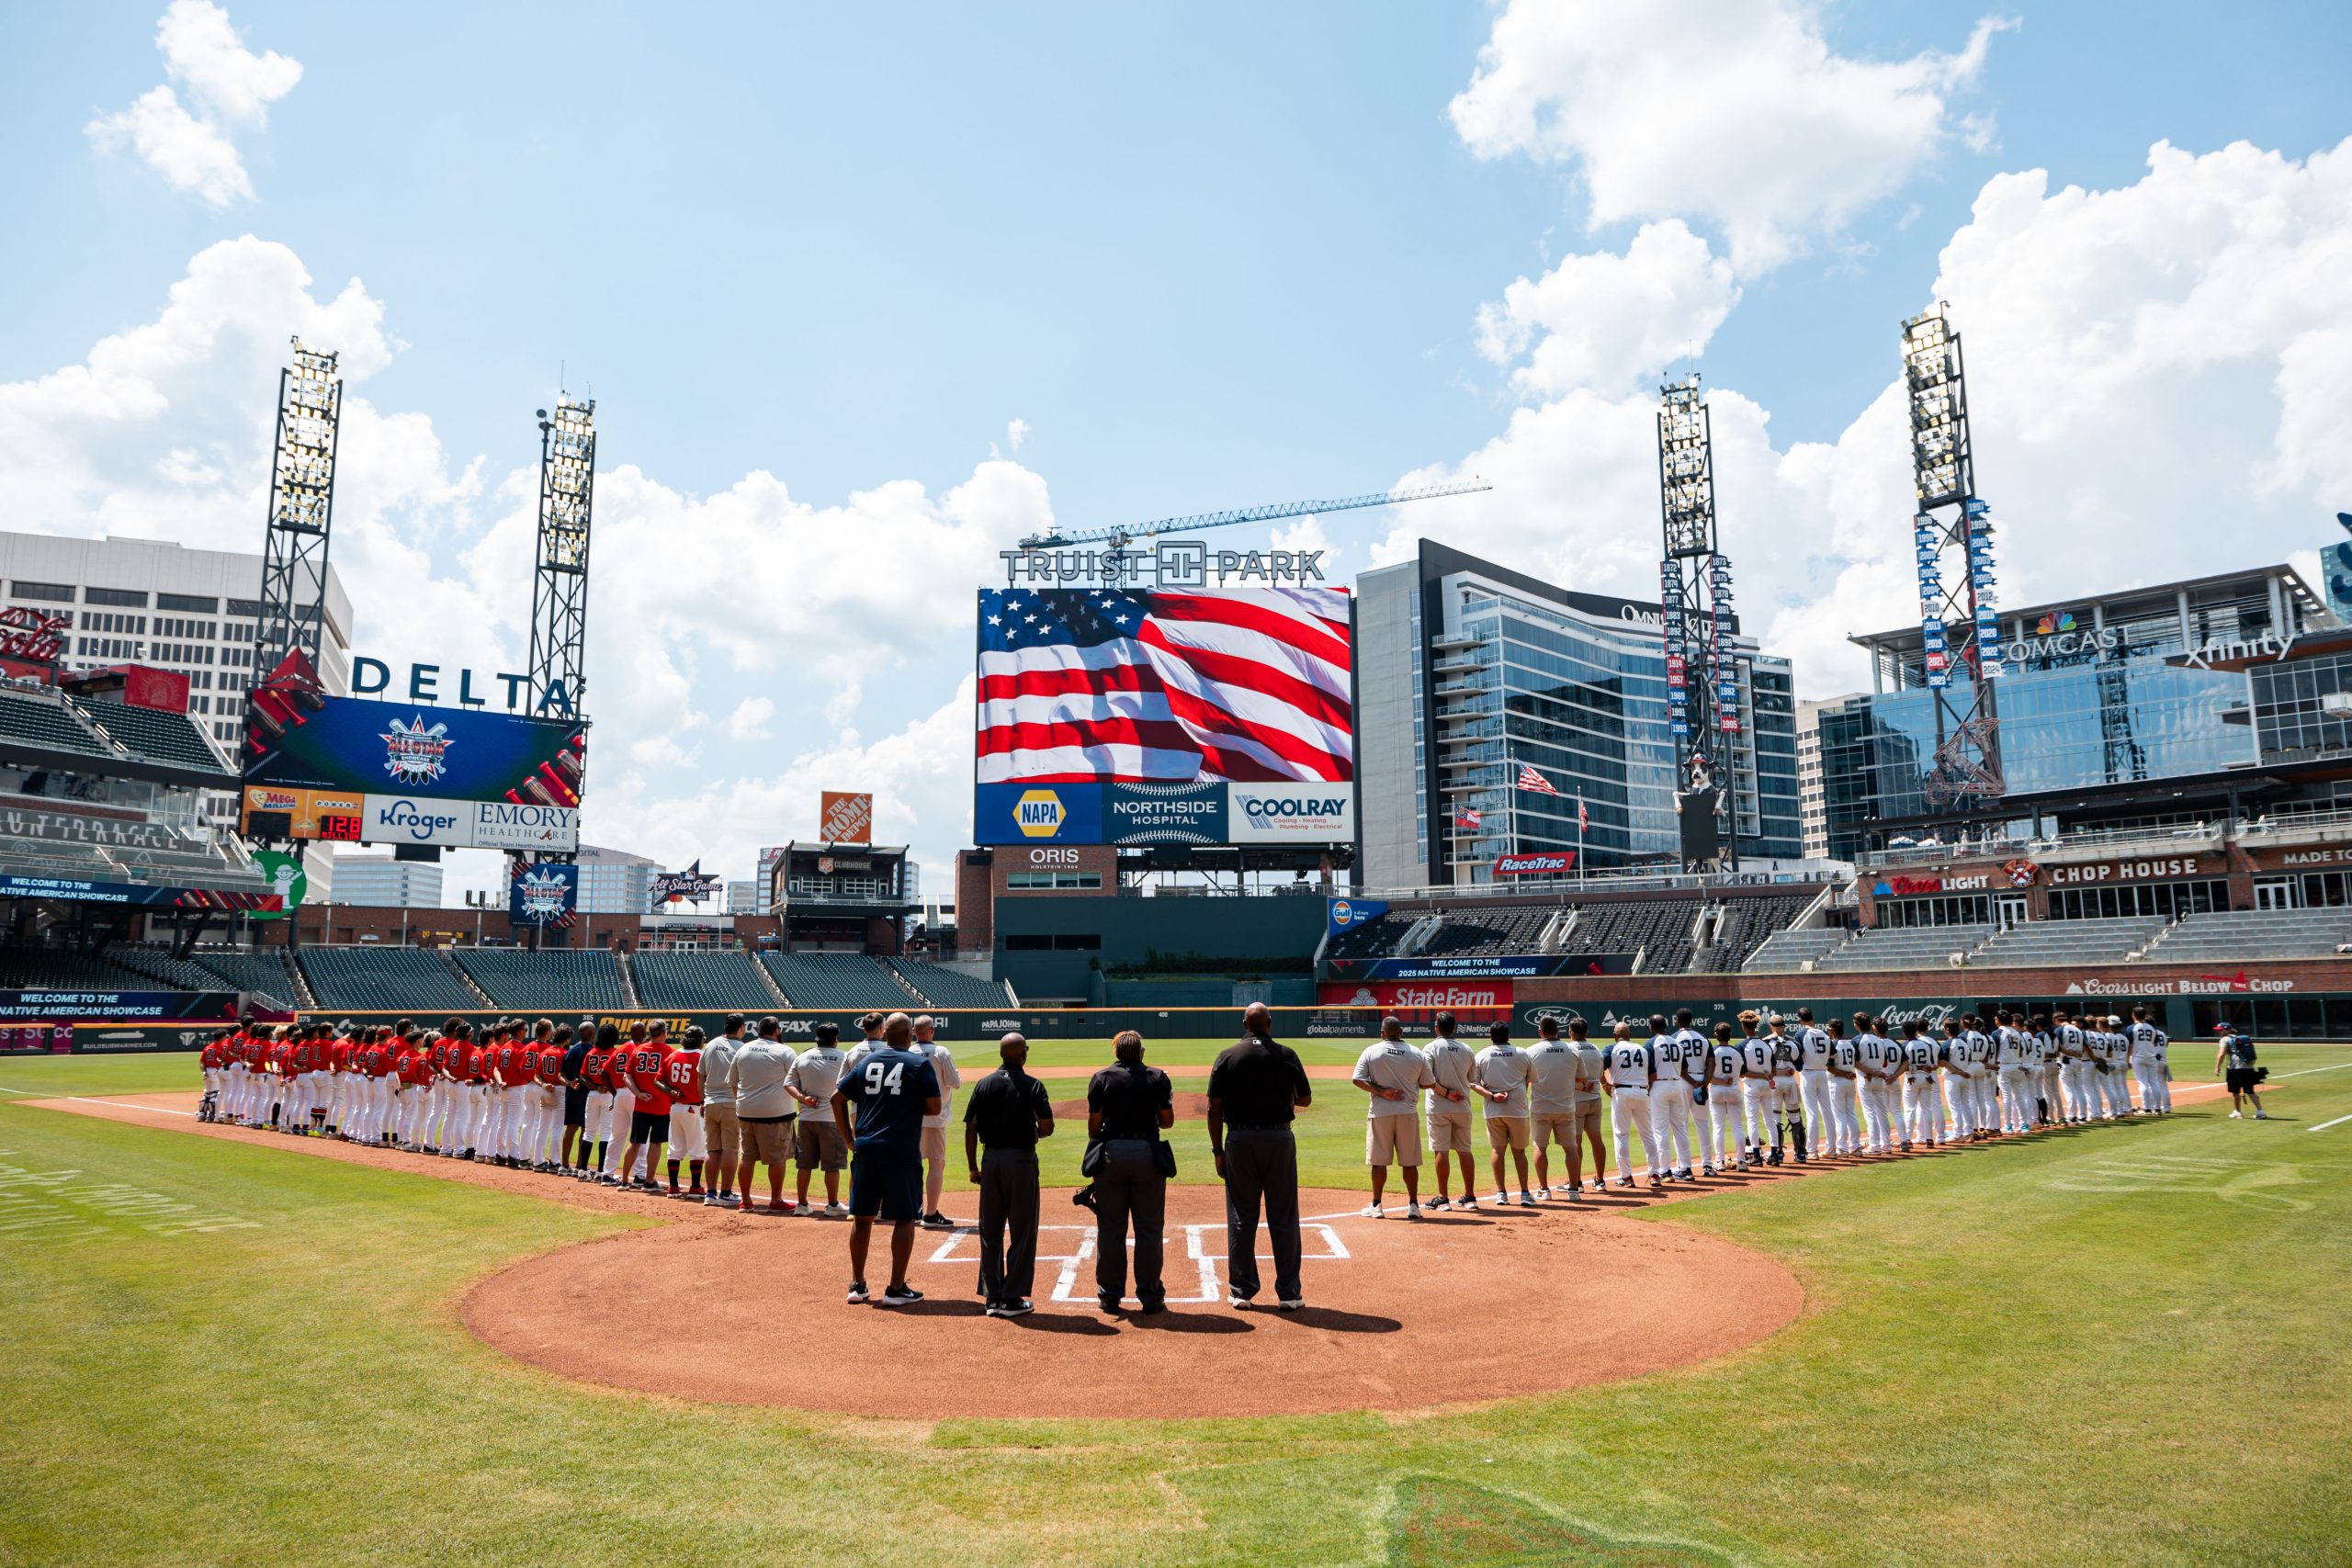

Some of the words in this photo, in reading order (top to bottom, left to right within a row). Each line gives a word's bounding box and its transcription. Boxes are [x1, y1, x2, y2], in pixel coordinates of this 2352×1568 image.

[999, 550, 1148, 582] TRUIST
[1217, 550, 1326, 581] PARK
[1663, 563, 1678, 571] 1872
[1712, 558, 1727, 566] 1873
[1713, 573, 1728, 582] 1875
[1665, 595, 1679, 604] 1877
[1925, 620, 1941, 630] 2013
[1980, 627, 1997, 637] 2020
[1668, 643, 1682, 651] 1897
[1981, 647, 1998, 657] 2022
[2185, 633, 2296, 670] xfinity
[1984, 664, 2000, 675] 2024
[1669, 675, 1684, 684] 1957
[352, 656, 574, 719] DELTA
[1671, 707, 1686, 716] 1991
[1721, 704, 1736, 713] 1992
[1672, 724, 1688, 733] 1993
[1722, 719, 1738, 729] 1995
[267, 793, 296, 804] MEGA
[827, 798, 848, 818] THE
[1022, 803, 1058, 823] NAPA
[1114, 802, 1217, 814] NORTHSIDE
[1245, 798, 1348, 817] COOLRAY
[379, 800, 457, 840] Kroger
[480, 804, 572, 828] EMORY
[821, 794, 873, 842] HOME
[1132, 816, 1199, 825] HOSPITAL
[328, 816, 361, 833] 128
[840, 812, 872, 843] DEPOT
[322, 831, 360, 840] MILLION
[479, 827, 568, 840] HEALTHCARE
[1030, 849, 1080, 863] ORIS
[2284, 851, 2333, 864] MADE
[834, 861, 871, 870] CLUBHOUSE
[1499, 857, 1566, 871] RaceTrac
[2052, 864, 2110, 883] CHOP
[2120, 859, 2198, 877] HOUSE
[11, 877, 59, 888] WELCOME
[1892, 875, 1940, 895] Coors
[1941, 875, 1989, 891] LIGHT
[0, 886, 31, 896] ATIVE
[32, 890, 77, 899] AMERICAN
[77, 893, 128, 902] SHOWCASE
[1334, 908, 1351, 917] Gulf
[1431, 959, 1471, 967] WELCOME
[2084, 979, 2131, 994] Coors
[2132, 983, 2174, 993] LIGHT
[2178, 980, 2231, 993] BELOW
[2250, 979, 2294, 992] CHOP
[20, 994, 77, 1003] WELCOME
[80, 995, 96, 1003] TO
[97, 995, 119, 1003] THE
[41, 1007, 100, 1015] AMERICAN
[103, 1007, 163, 1015] SHOWCASE
[1880, 1005, 1957, 1031] Coca-Col
[1622, 1015, 1668, 1027] Geora
[1307, 1024, 1365, 1035] globalpayments
[2069, 1031, 2080, 1044] 21
[388, 1043, 396, 1059] 4
[1660, 1043, 1680, 1063] 30
[1681, 1039, 1703, 1057] 28
[1812, 1037, 1826, 1055] 15
[1868, 1043, 1880, 1059] 11
[1973, 1038, 1984, 1053] 17
[298, 1046, 310, 1062] 15
[436, 1045, 446, 1063] 9
[449, 1048, 459, 1066] 19
[1620, 1049, 1644, 1068] 34
[1755, 1047, 1764, 1066] 9
[1842, 1048, 1853, 1066] 19
[1911, 1048, 1927, 1065] 12
[398, 1056, 410, 1074] 12
[542, 1055, 556, 1075] 10
[636, 1051, 662, 1074] 33
[1721, 1055, 1733, 1074] 6
[671, 1062, 693, 1085] 65
[865, 1062, 905, 1096] 94
